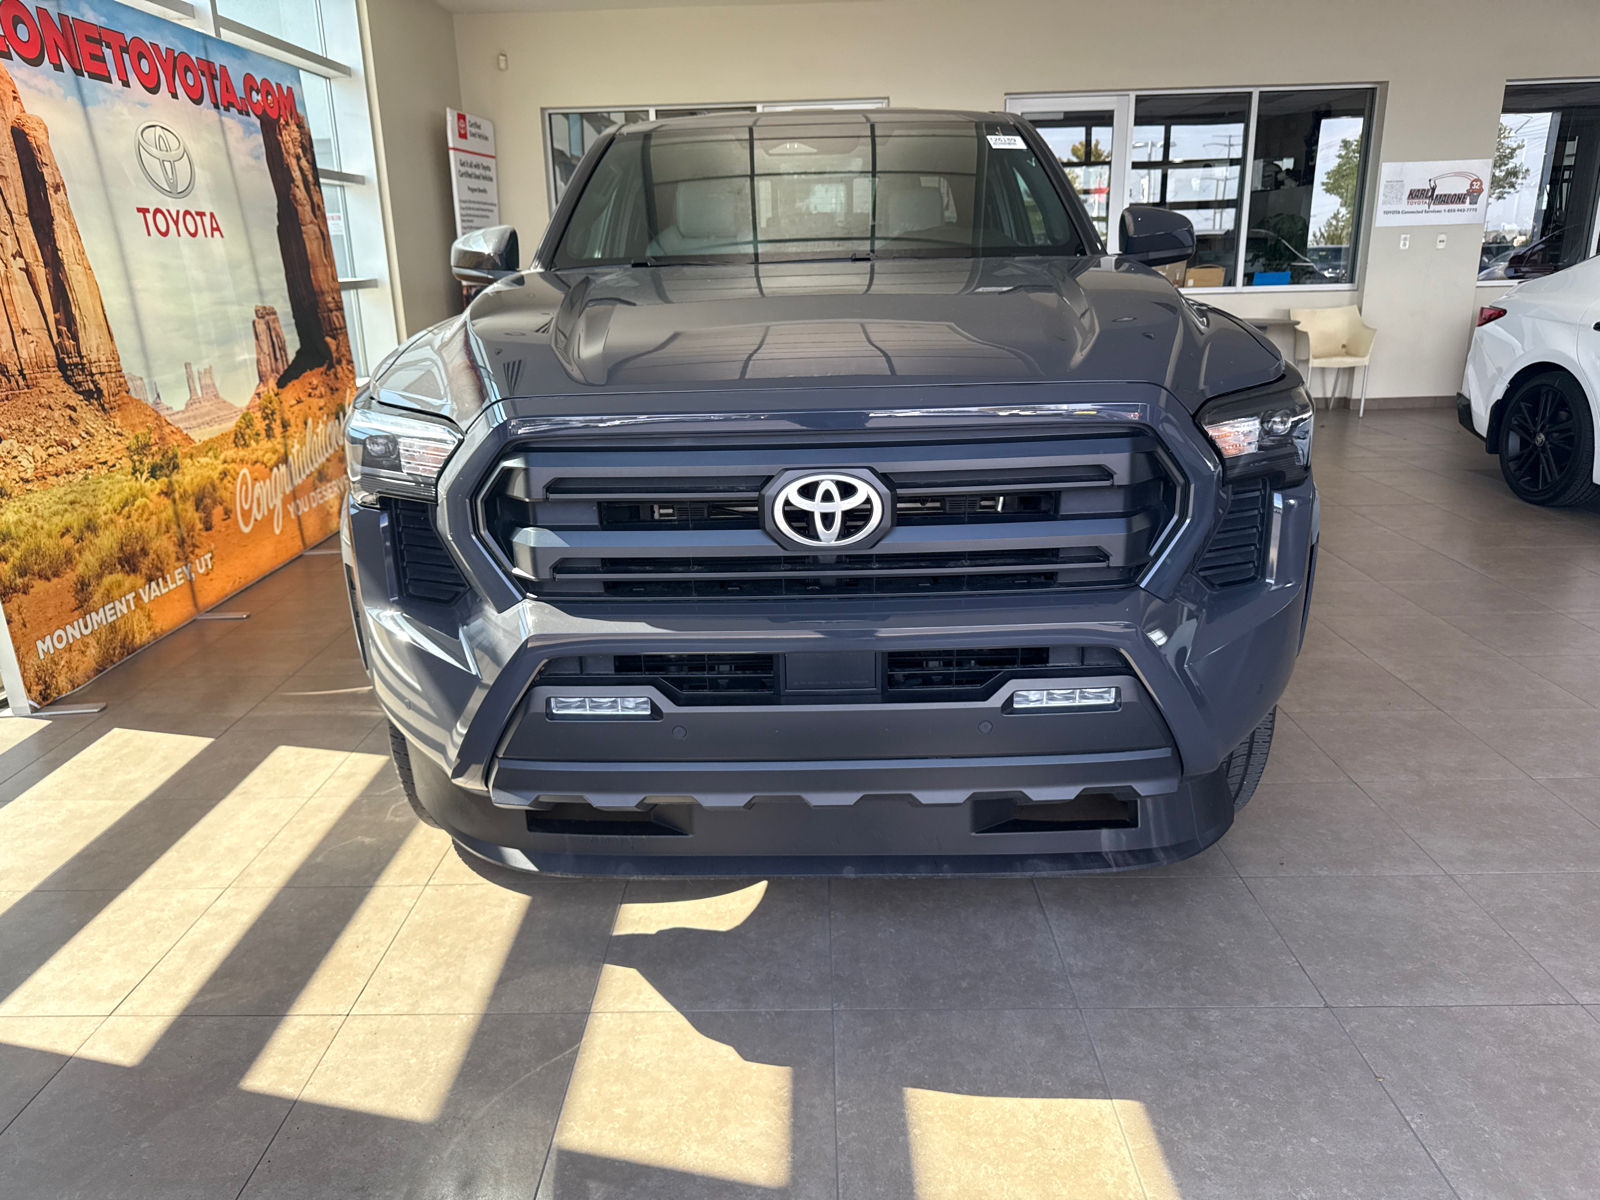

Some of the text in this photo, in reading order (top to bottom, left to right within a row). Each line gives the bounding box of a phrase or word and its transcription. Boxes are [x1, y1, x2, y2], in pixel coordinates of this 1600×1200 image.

[0, 0, 300, 123] ONETOYOTA.COM
[1407, 189, 1468, 205] KARL MALONE
[1472, 181, 1480, 189] 32
[136, 206, 225, 239] TOYOTA
[286, 495, 310, 520] YOU
[35, 551, 213, 660] MONUMENT VALLEY, UT
